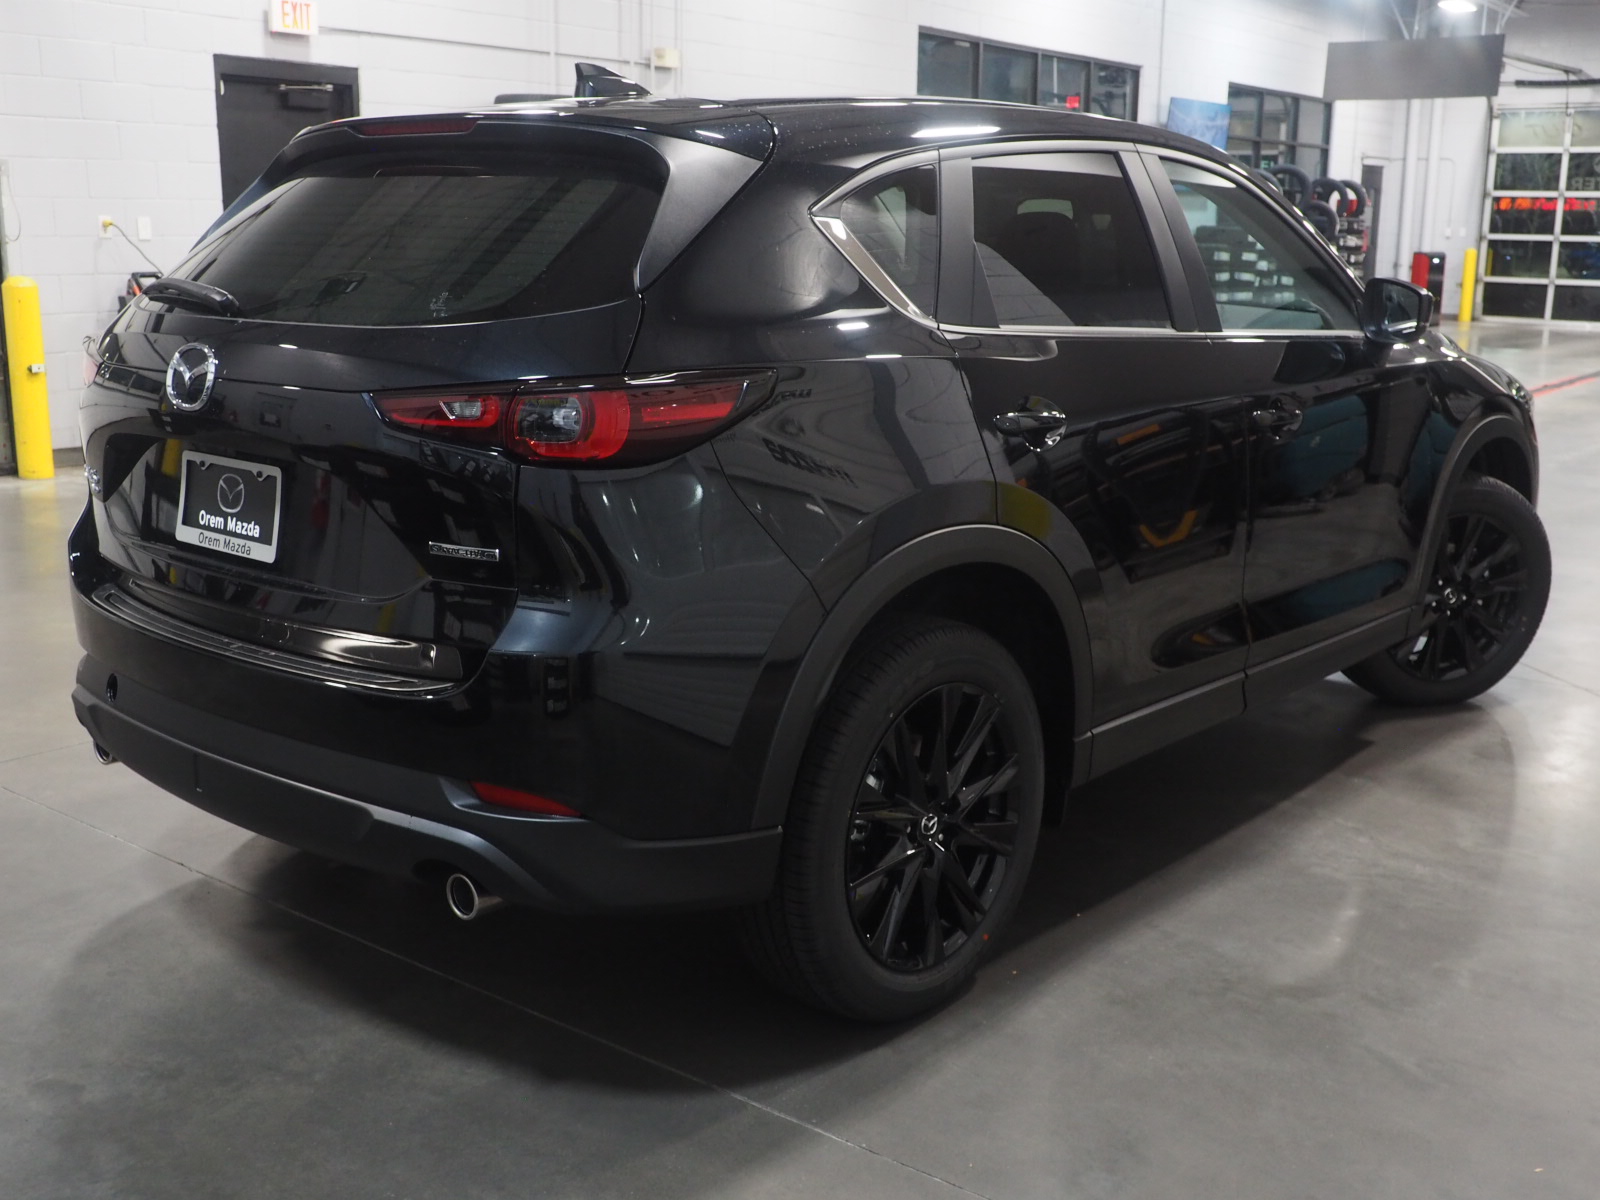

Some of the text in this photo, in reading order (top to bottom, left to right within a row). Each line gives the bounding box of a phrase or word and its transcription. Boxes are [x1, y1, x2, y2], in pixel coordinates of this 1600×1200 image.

[281, 0, 311, 30] EXIT
[199, 510, 260, 538] Orem Mazda
[198, 532, 252, 555] Orem Mazda
